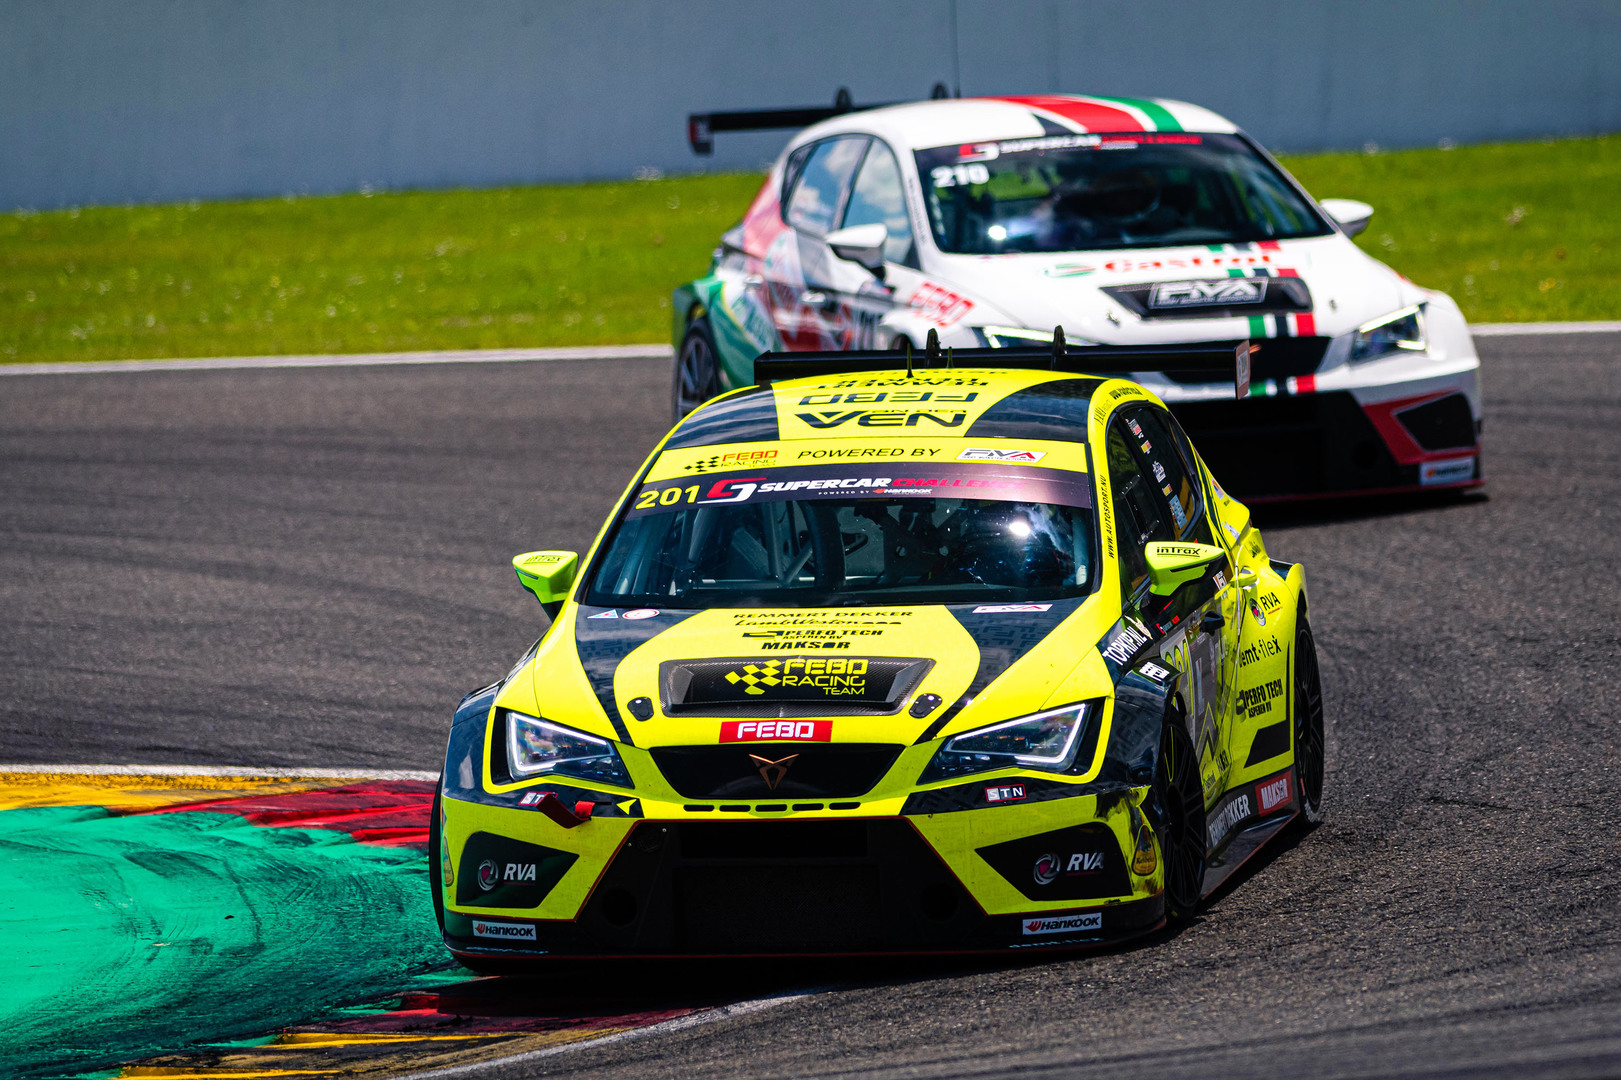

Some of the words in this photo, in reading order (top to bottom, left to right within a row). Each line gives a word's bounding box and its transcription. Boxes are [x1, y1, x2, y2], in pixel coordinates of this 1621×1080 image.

[931, 163, 989, 187] 210
[798, 392, 979, 405] FEBO
[722, 450, 778, 462] FEBO
[797, 448, 905, 459] POWERED
[911, 448, 941, 457] BY
[757, 478, 892, 493] SUPERCAR
[635, 484, 700, 510] 201
[1100, 475, 1115, 560] WWW.AUTOSPORT.NU
[1260, 592, 1281, 611] RVA
[1102, 625, 1148, 666] TOPKIP.NL
[784, 658, 869, 675] FEBO
[781, 675, 866, 687] RACING
[822, 687, 865, 695] TEAM
[1244, 685, 1267, 708] PERFO
[1265, 679, 1284, 699] TECH
[737, 721, 815, 738] FEBO
[988, 786, 1024, 800] STN
[1066, 852, 1104, 871] RVA
[503, 863, 537, 881] RVA
